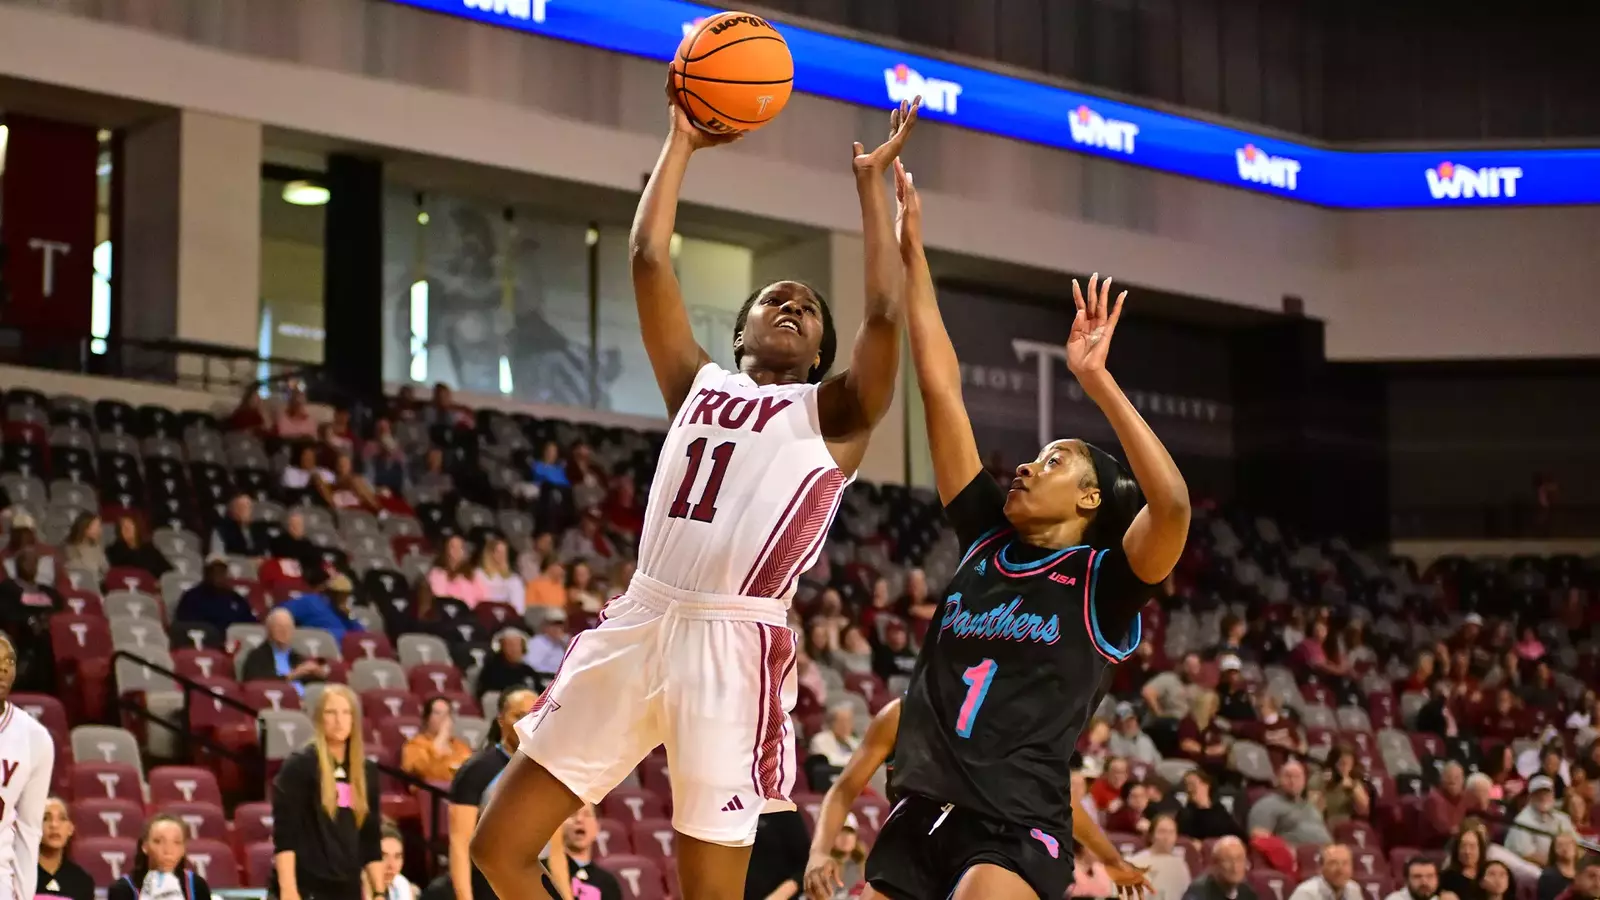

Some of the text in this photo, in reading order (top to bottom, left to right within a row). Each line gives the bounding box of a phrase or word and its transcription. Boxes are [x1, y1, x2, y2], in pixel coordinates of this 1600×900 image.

[1068, 109, 1139, 154] WNIT
[1235, 147, 1301, 191] WNIT
[1426, 164, 1522, 199] WNIT
[28, 238, 71, 297] T
[668, 437, 736, 523] 11
[1048, 571, 1076, 586] USA
[937, 592, 1061, 645] Panthers
[956, 657, 998, 738] 1
